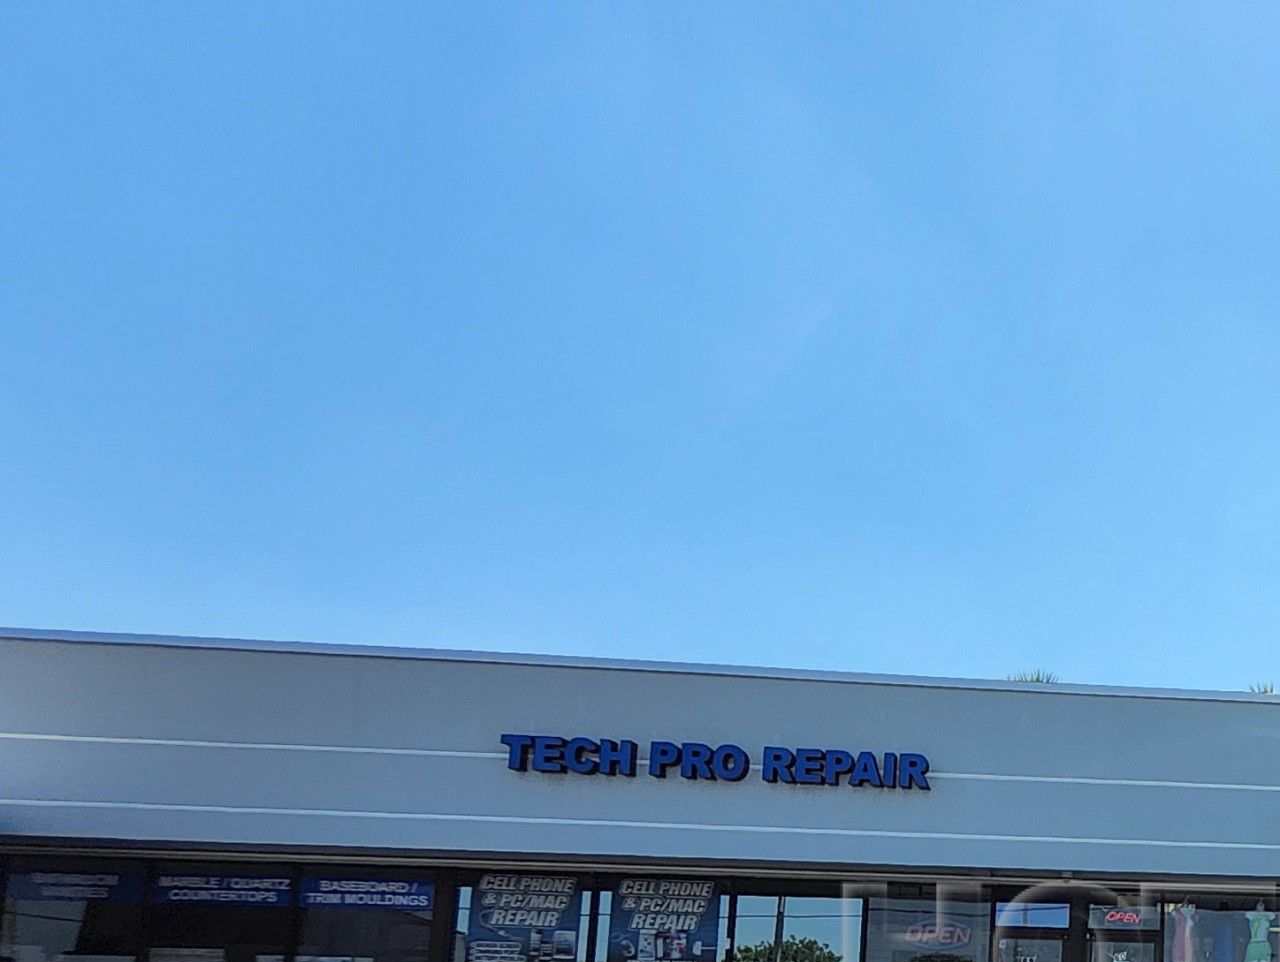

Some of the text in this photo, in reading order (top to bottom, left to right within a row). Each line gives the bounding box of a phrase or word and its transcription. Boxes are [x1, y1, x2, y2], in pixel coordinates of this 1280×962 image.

[500, 733, 931, 791] TECH PRO REPAIR
[320, 880, 409, 893] BASEBOARD
[480, 875, 575, 892] CELL PHONE
[621, 880, 712, 897] CELL PHONE
[344, 894, 429, 906] MOULDINGS
[500, 893, 568, 909] PC/MAC
[639, 898, 706, 913] PC/MAC
[490, 910, 559, 927] REPAIR
[630, 913, 699, 931] REPAIR
[1105, 911, 1142, 924] OPEN
[904, 925, 973, 945] OPEN
